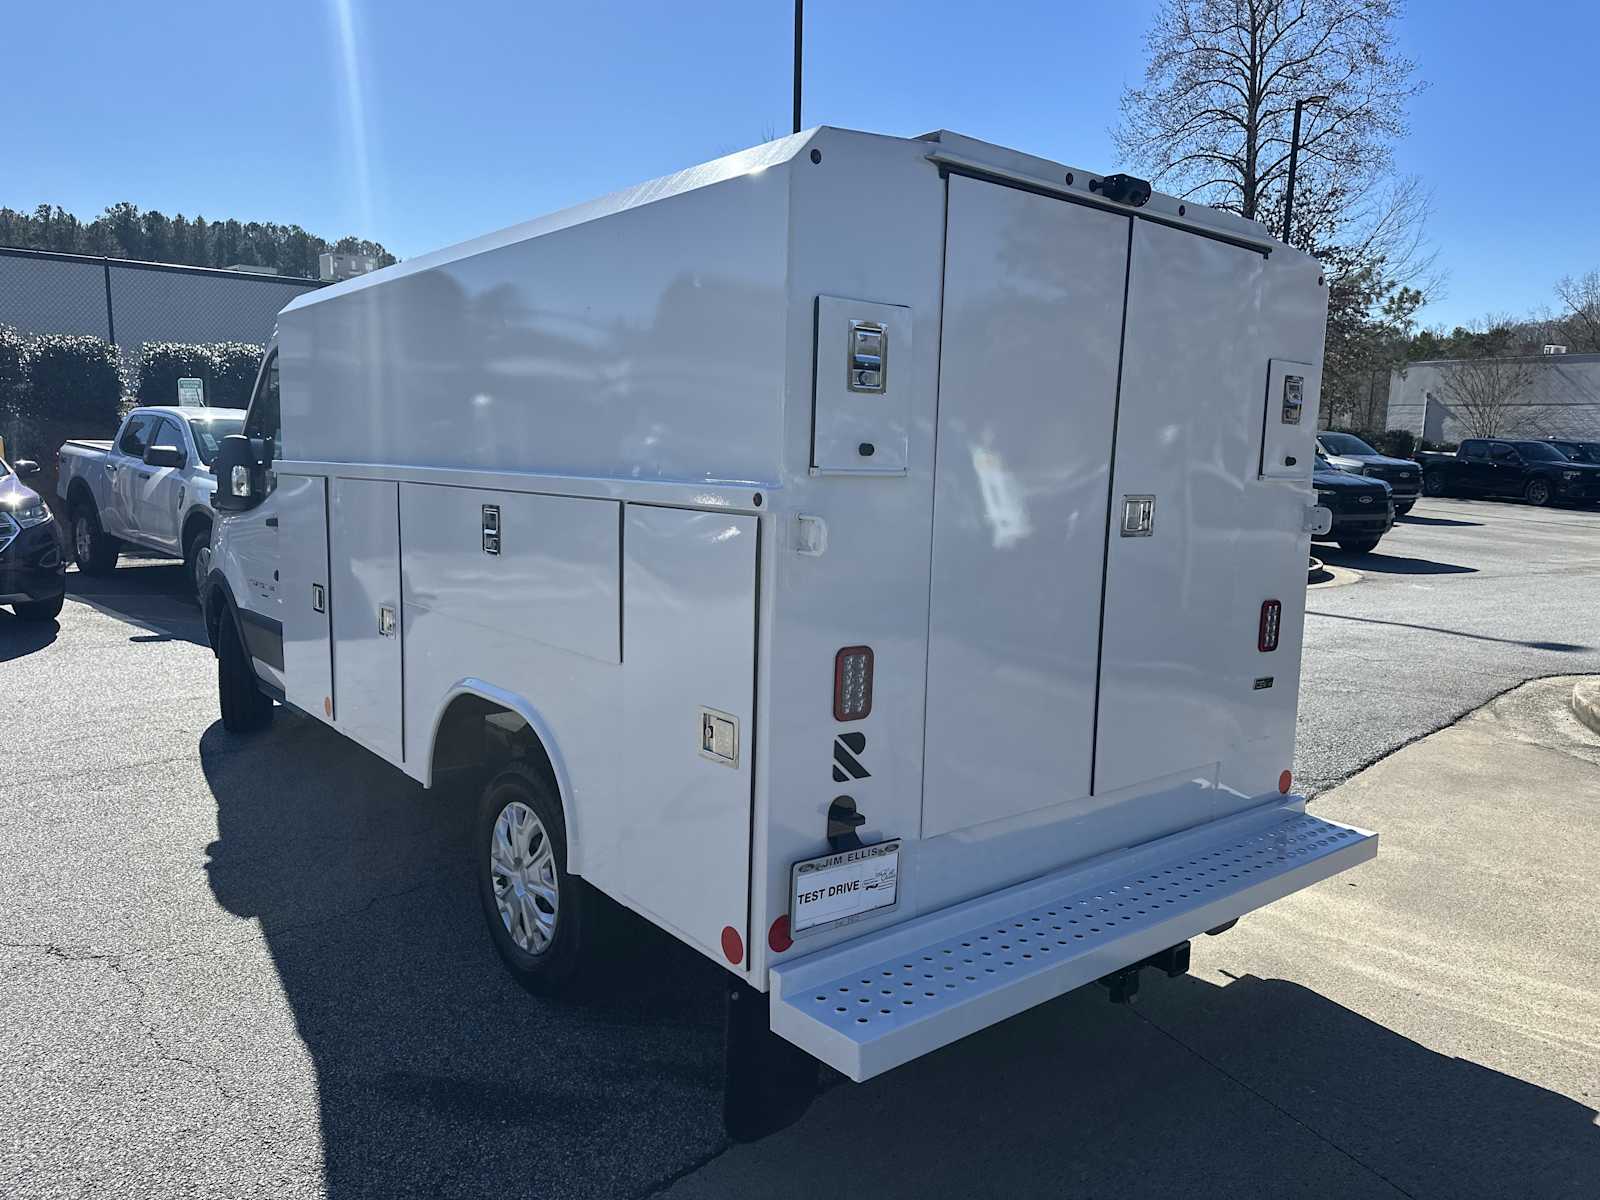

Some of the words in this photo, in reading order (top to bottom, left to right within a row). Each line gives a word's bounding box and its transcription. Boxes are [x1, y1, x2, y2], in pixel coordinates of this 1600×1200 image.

[823, 856, 843, 868] JIM
[847, 847, 878, 862] ELLIS
[798, 889, 826, 904] TEST
[828, 880, 860, 896] DRIVE
